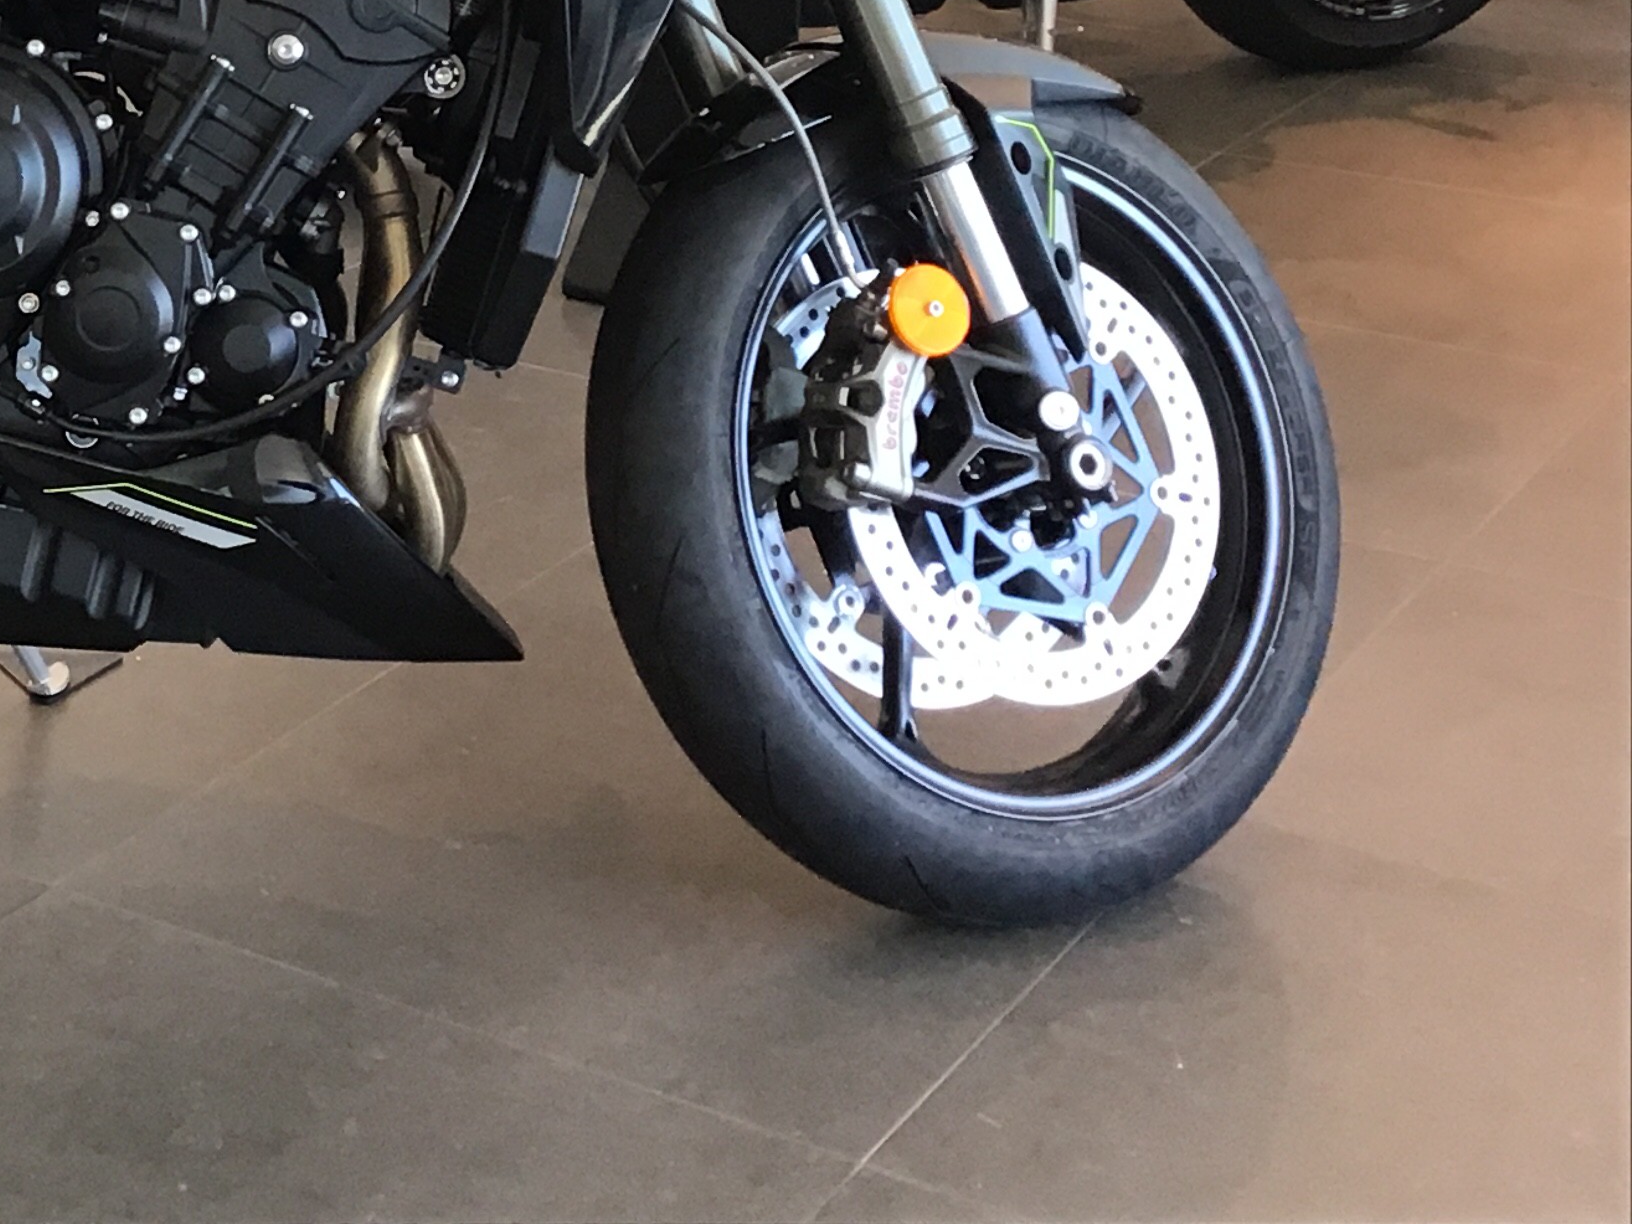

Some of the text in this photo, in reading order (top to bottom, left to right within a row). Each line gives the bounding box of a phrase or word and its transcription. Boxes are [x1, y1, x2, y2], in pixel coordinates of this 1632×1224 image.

[881, 361, 908, 450] brembo
[107, 501, 185, 532] FOR THE RIDE
